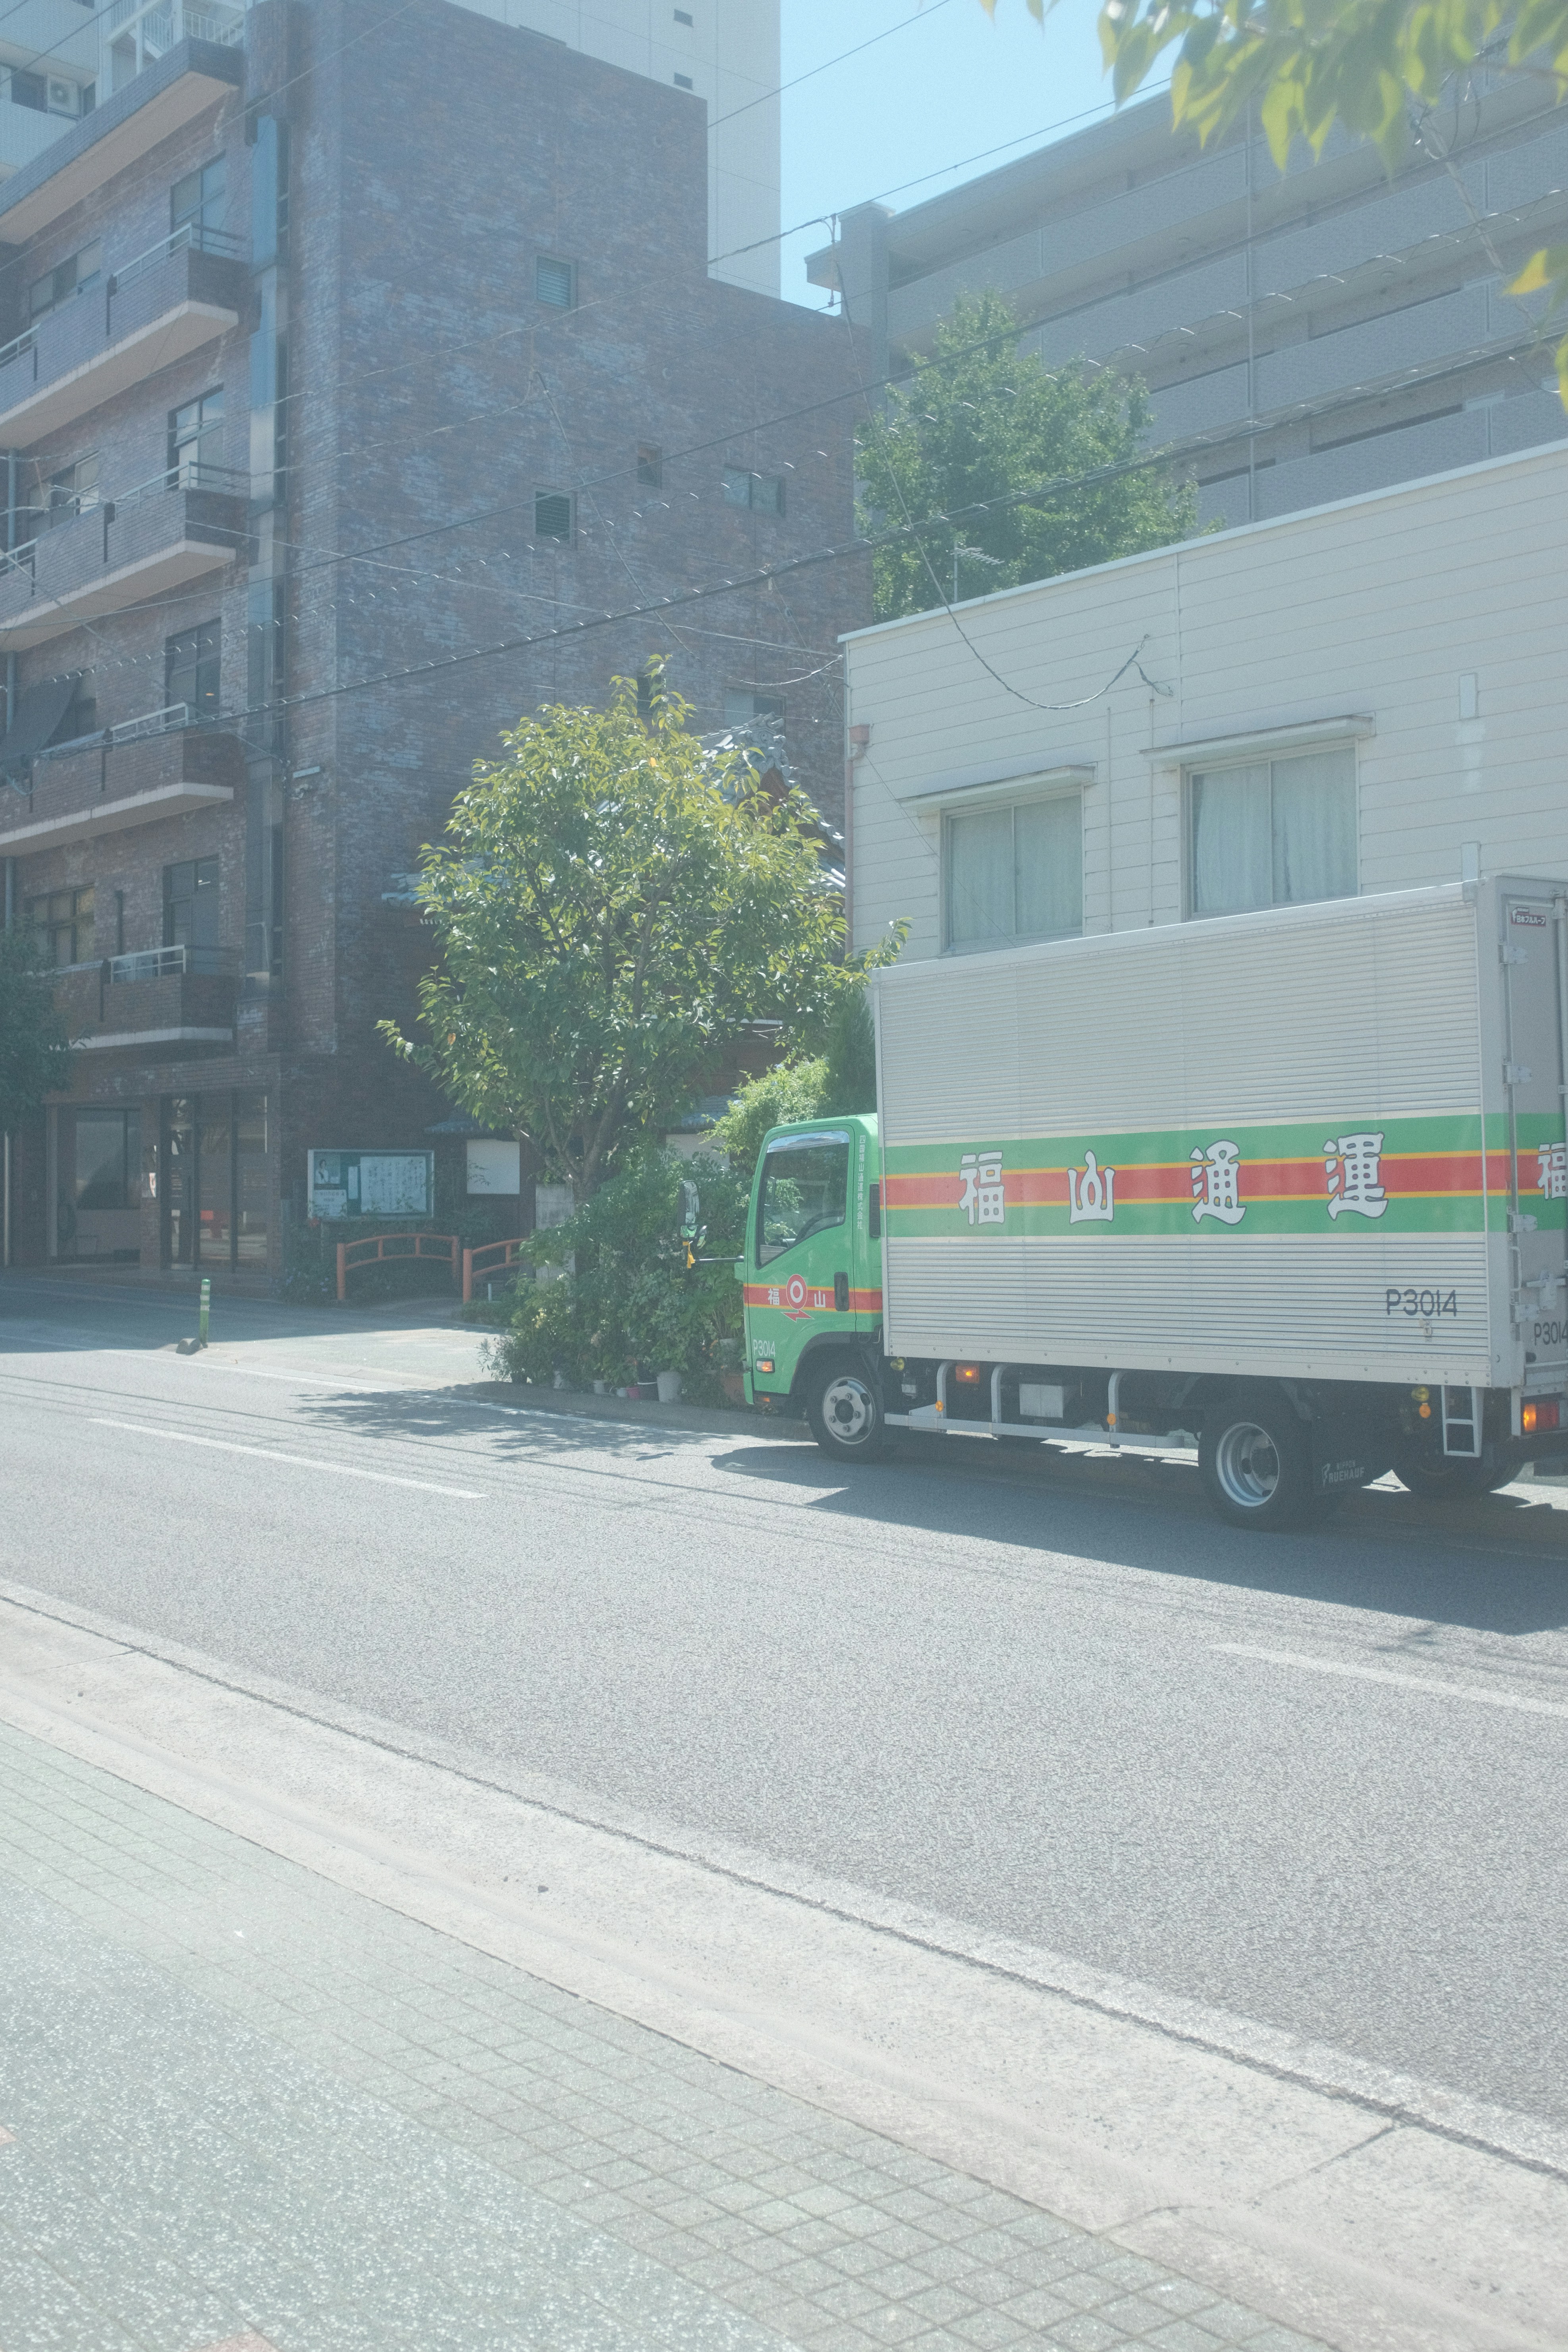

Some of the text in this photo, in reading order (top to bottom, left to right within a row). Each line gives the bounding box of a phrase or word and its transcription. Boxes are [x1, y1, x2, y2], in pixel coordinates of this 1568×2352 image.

[1517, 915, 1545, 924] 日本フルハーフ
[857, 1135, 866, 1229] 四国福山通運株式会社
[959, 1132, 1389, 1226] 福山通運
[1537, 1142, 1567, 1200] 福
[1386, 1289, 1457, 1316] P3014
[1535, 1320, 1568, 1346] P3014
[754, 1339, 776, 1357] P3014
